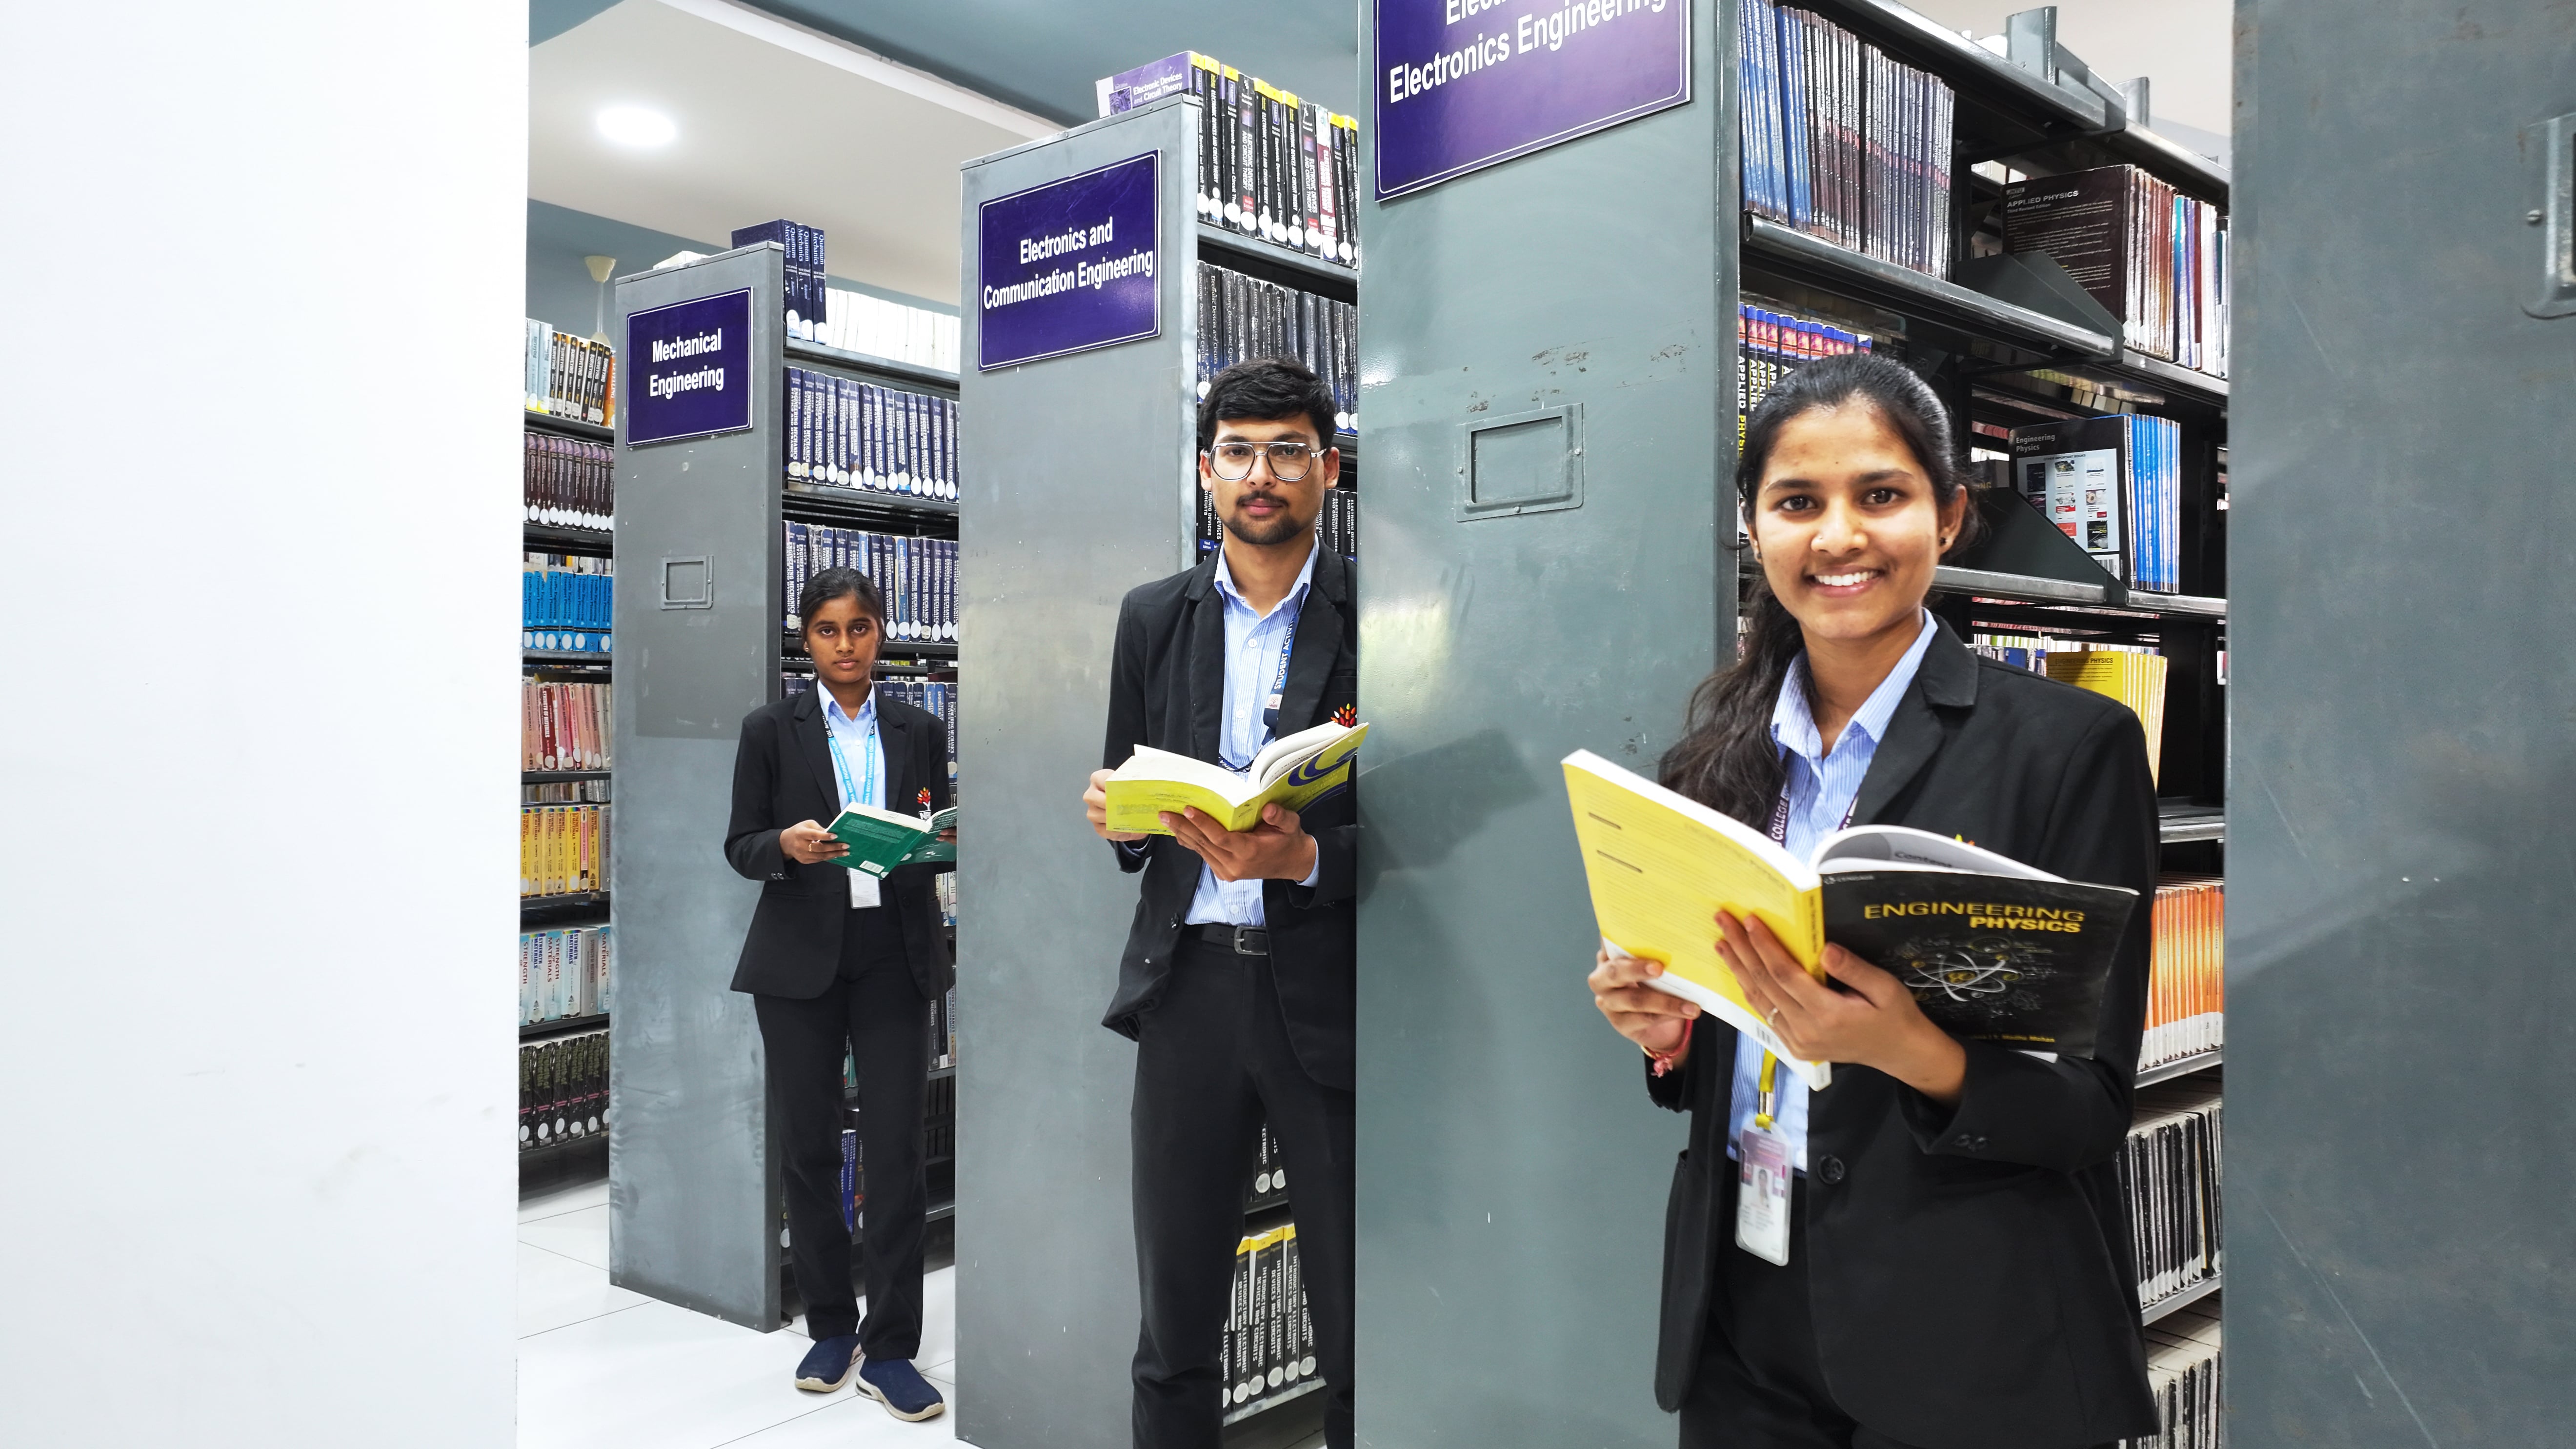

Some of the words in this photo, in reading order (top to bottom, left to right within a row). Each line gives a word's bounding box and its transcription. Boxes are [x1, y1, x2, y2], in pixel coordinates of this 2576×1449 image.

[1390, 33, 1509, 103] Electronics
[1133, 80, 1160, 95] Electronic
[1160, 73, 1182, 84] Devices
[1144, 88, 1161, 101] Circuit
[1162, 82, 1182, 94] Theory
[2007, 197, 2041, 208] APPLIED
[2043, 190, 2079, 201] PHYSICS
[1020, 227, 1086, 264] Electronics
[1089, 216, 1113, 246] and
[984, 268, 1074, 310] Communication
[1078, 248, 1154, 290] Engineering
[653, 328, 721, 362] Mechanical
[601, 358, 609, 382] SURVEYING
[650, 365, 724, 399] Engineering
[1738, 356, 1746, 409] APPLIED
[2016, 434, 2055, 444] Engineering
[2016, 444, 2040, 453] Physics
[1274, 653, 1288, 689] STUDENT
[837, 754, 849, 779] ENGINEERING
[1771, 800, 1790, 840] COLLEGE
[1864, 901, 2085, 922] ENGINEERING
[1970, 916, 2082, 933] PHYSICS
